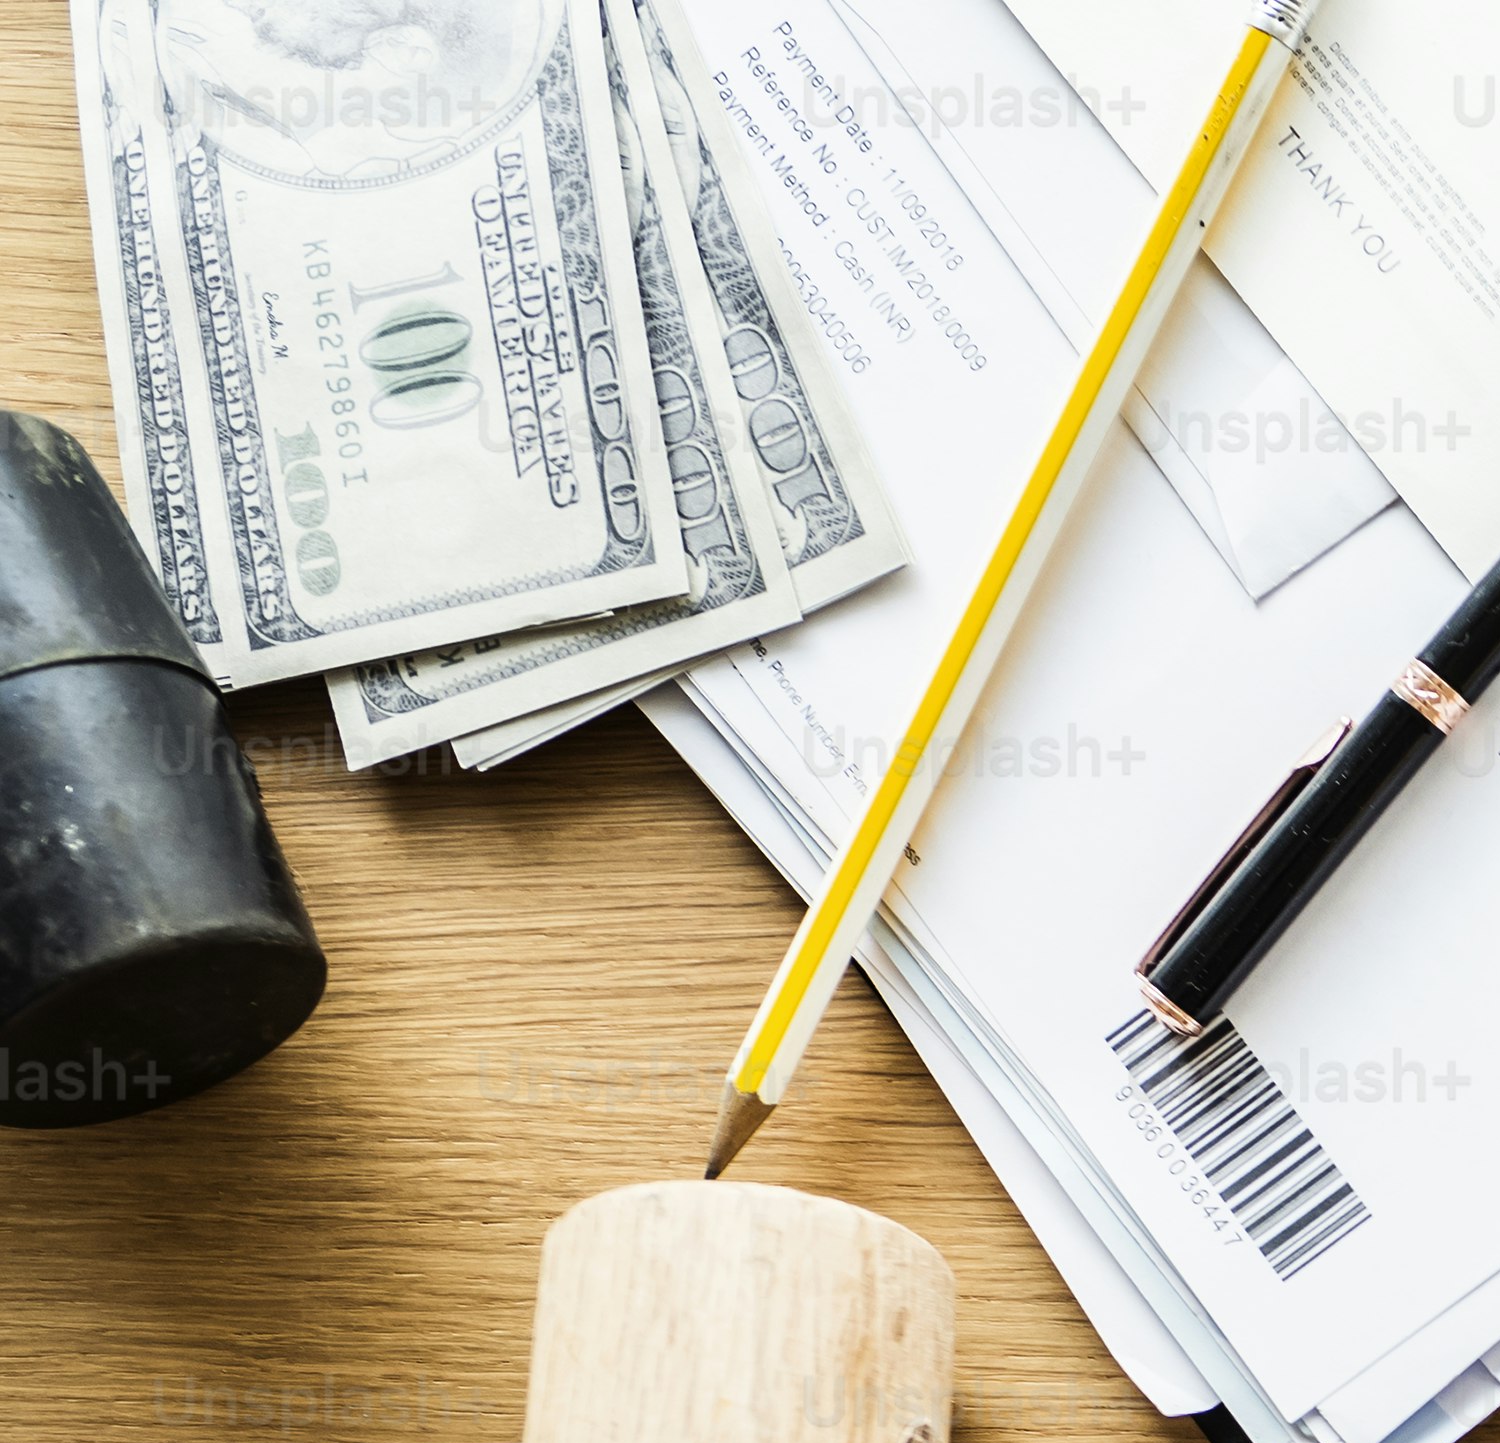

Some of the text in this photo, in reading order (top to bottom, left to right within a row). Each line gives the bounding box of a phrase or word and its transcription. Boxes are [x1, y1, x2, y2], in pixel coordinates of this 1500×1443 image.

[740, 46, 814, 143] Reference
[812, 143, 838, 175] No
[772, 20, 964, 272] Payment Date 11/09/2018
[712, 71, 917, 344] Payment Method Cash (INR)
[1278, 125, 1401, 274] THANK YOU
[347, 261, 484, 430] 100
[571, 286, 645, 545] 100
[275, 421, 341, 597] 100
